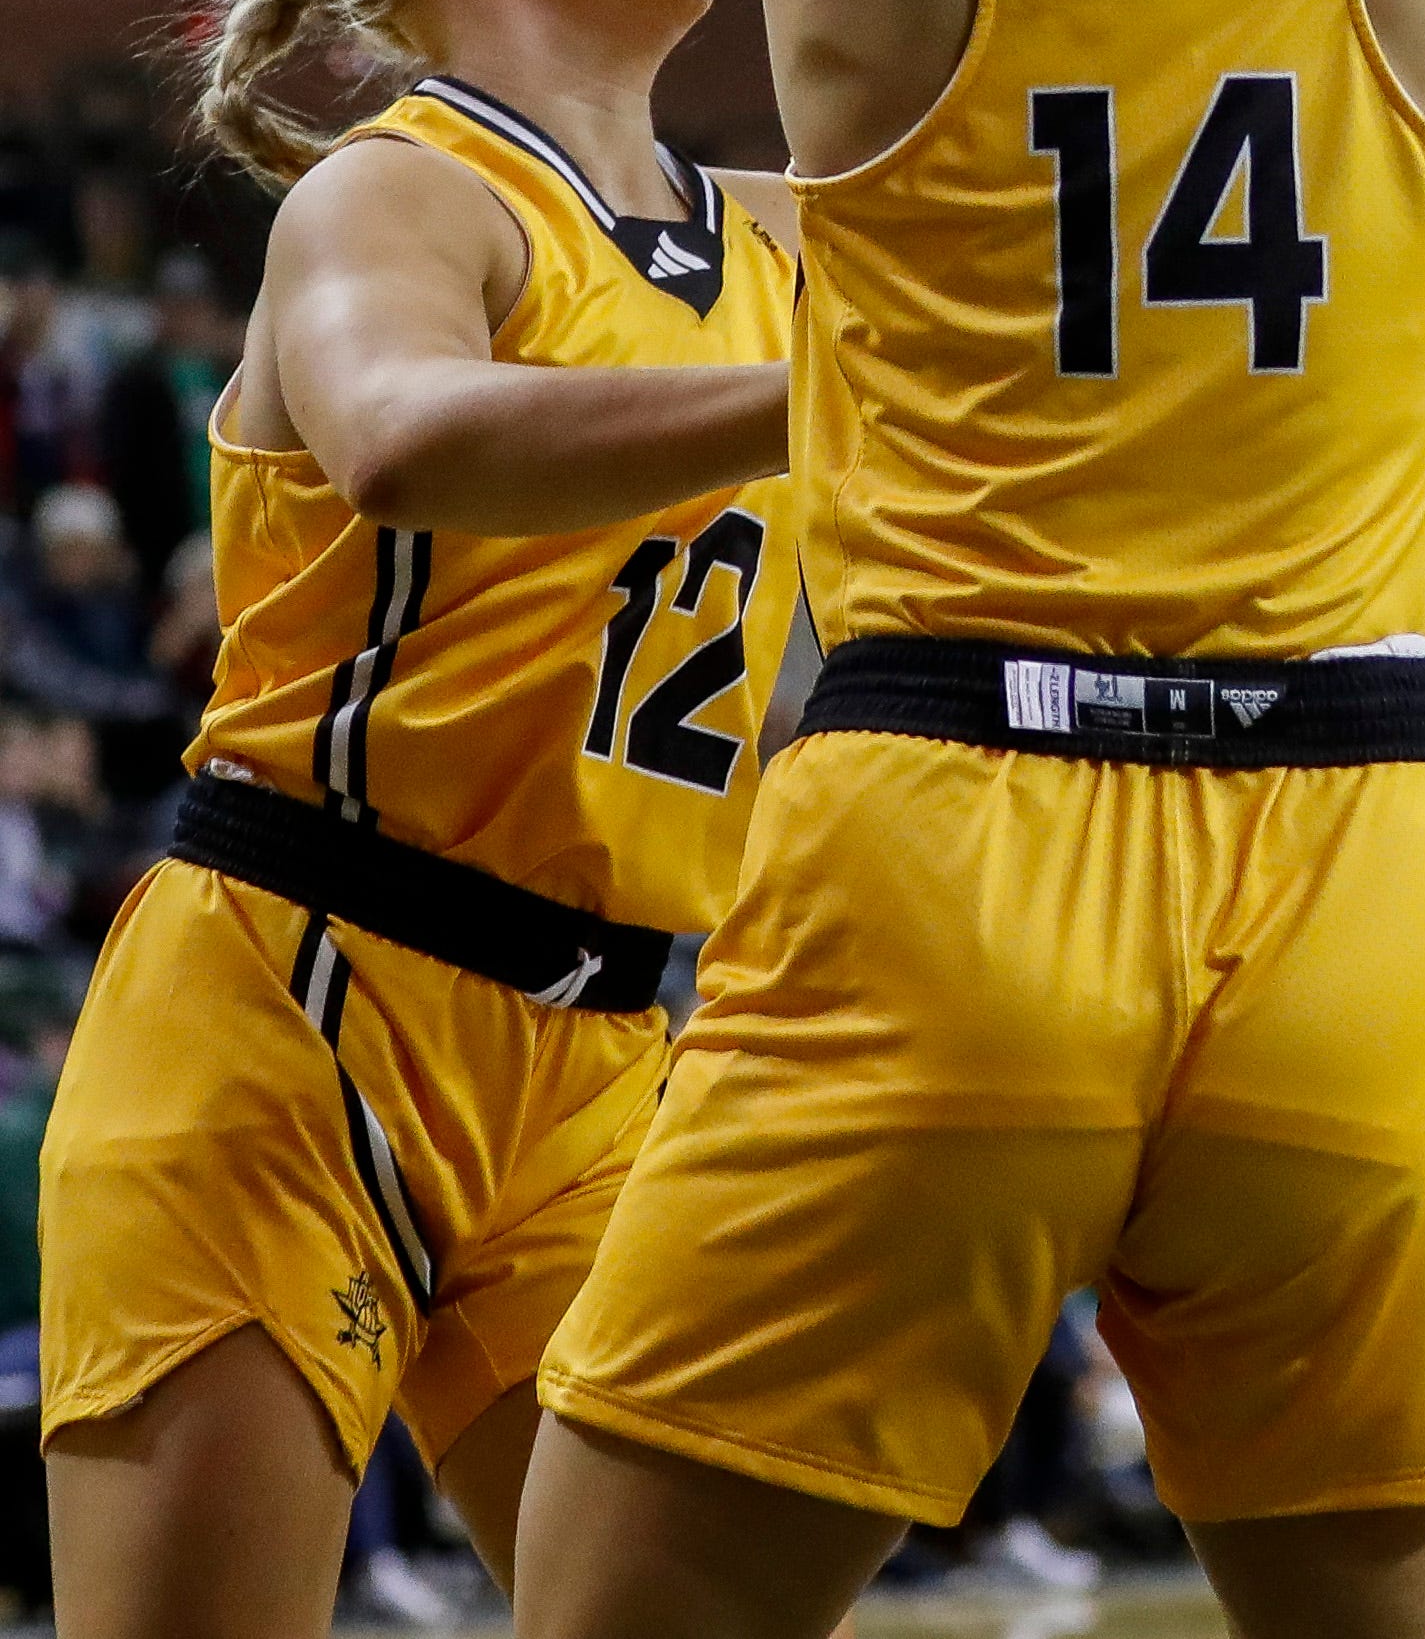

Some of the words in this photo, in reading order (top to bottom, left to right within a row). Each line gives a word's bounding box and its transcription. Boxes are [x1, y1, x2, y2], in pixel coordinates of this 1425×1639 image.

[1028, 72, 1330, 380] 14
[581, 508, 766, 797] 12
[1221, 688, 1278, 704] adidas
